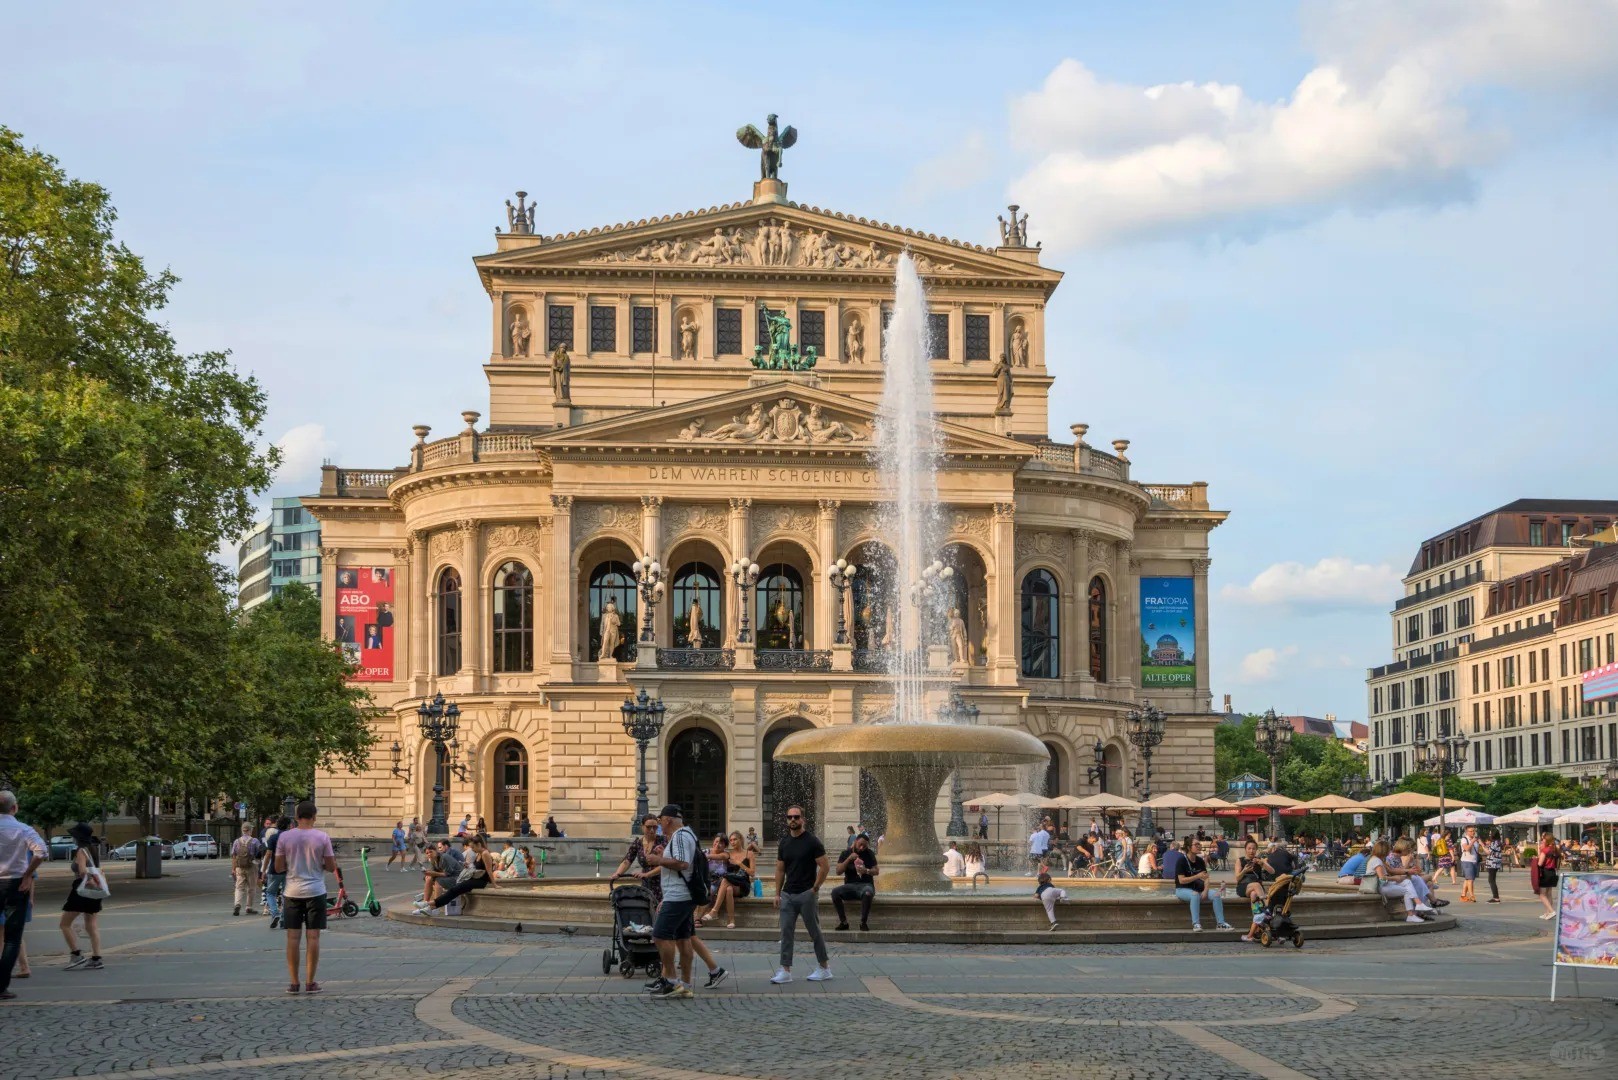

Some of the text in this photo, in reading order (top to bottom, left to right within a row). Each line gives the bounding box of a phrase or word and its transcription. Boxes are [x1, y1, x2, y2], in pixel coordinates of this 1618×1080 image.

[649, 467, 682, 480] DEM
[690, 468, 759, 481] WAHREN
[768, 469, 853, 483] SCHOENEN
[340, 594, 371, 605] ABO
[1145, 597, 1189, 605] FRATOPIA
[365, 667, 390, 676] OPER
[1145, 673, 1192, 682] ALTE OPER
